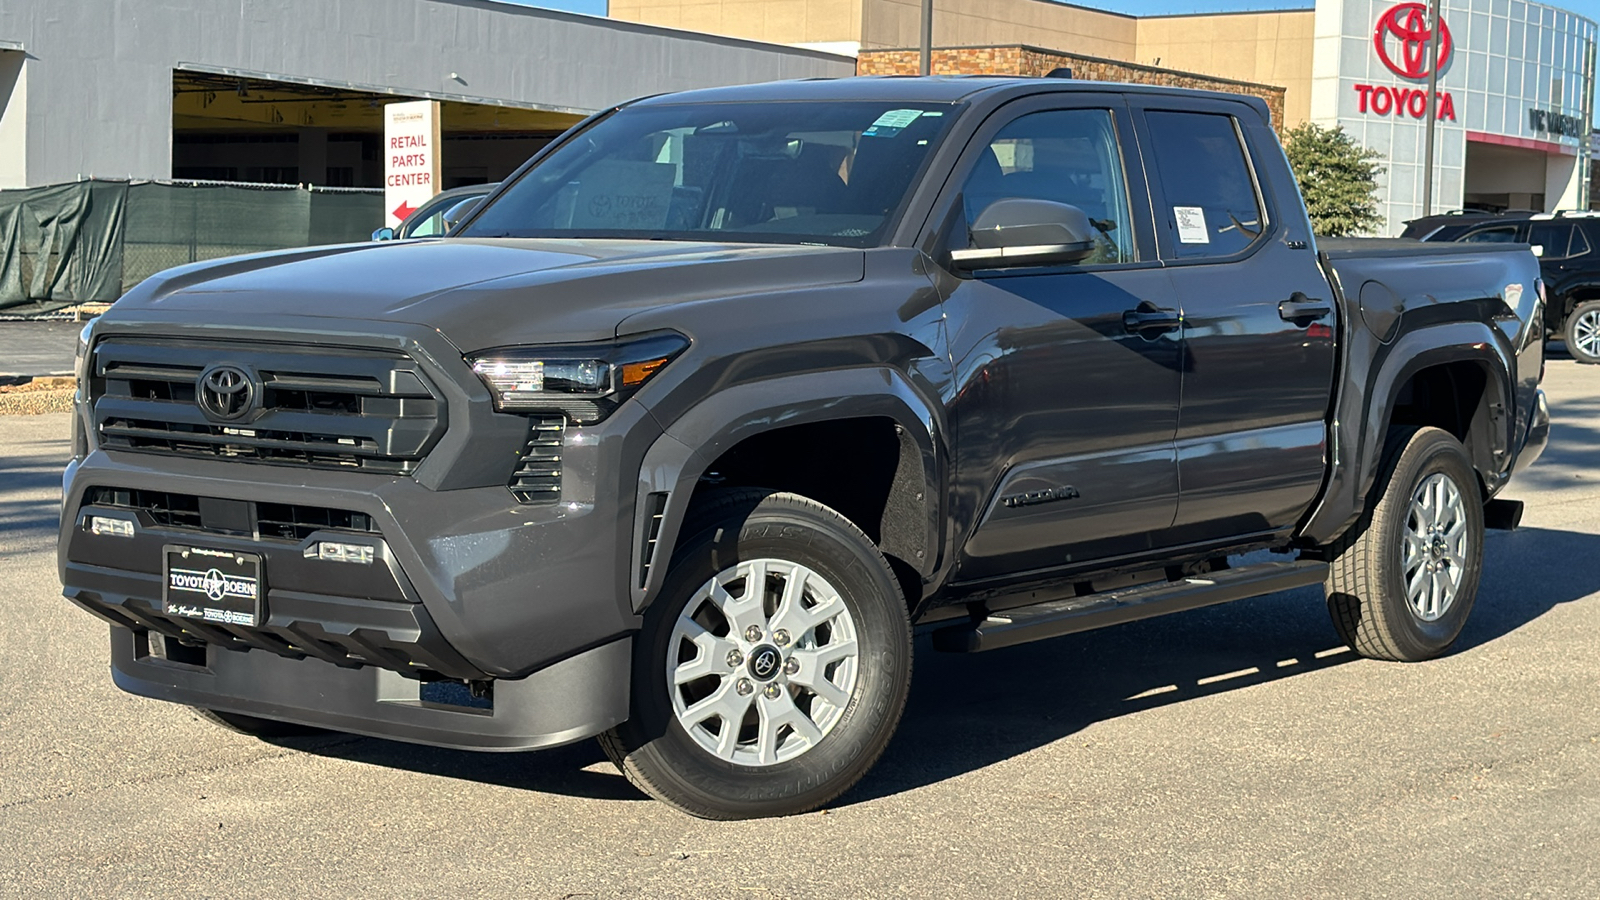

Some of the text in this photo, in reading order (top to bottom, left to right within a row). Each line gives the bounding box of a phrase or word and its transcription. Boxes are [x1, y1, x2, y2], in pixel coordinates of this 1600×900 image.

[391, 135, 427, 149] RETAIL
[392, 154, 425, 168] PARTS
[387, 172, 430, 187] CENTER
[170, 573, 210, 590] TOYOTA
